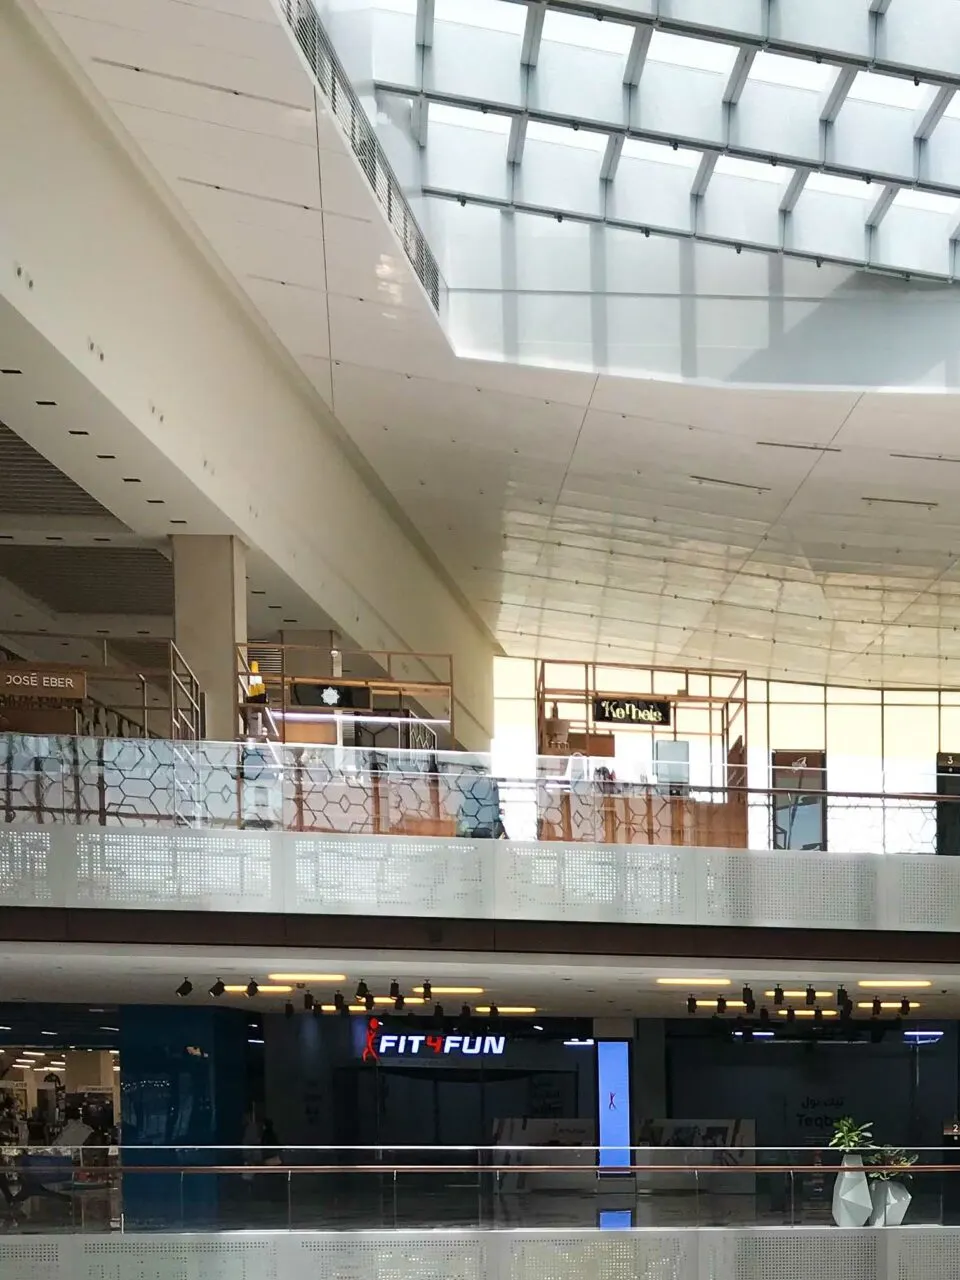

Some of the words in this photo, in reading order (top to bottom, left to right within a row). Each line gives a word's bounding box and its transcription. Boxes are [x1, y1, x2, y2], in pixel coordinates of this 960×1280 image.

[42, 676, 74, 688] EBER
[947, 755, 954, 765] 3
[379, 1035, 506, 1054] FIT4FUN
[952, 1124, 959, 1133] 2
